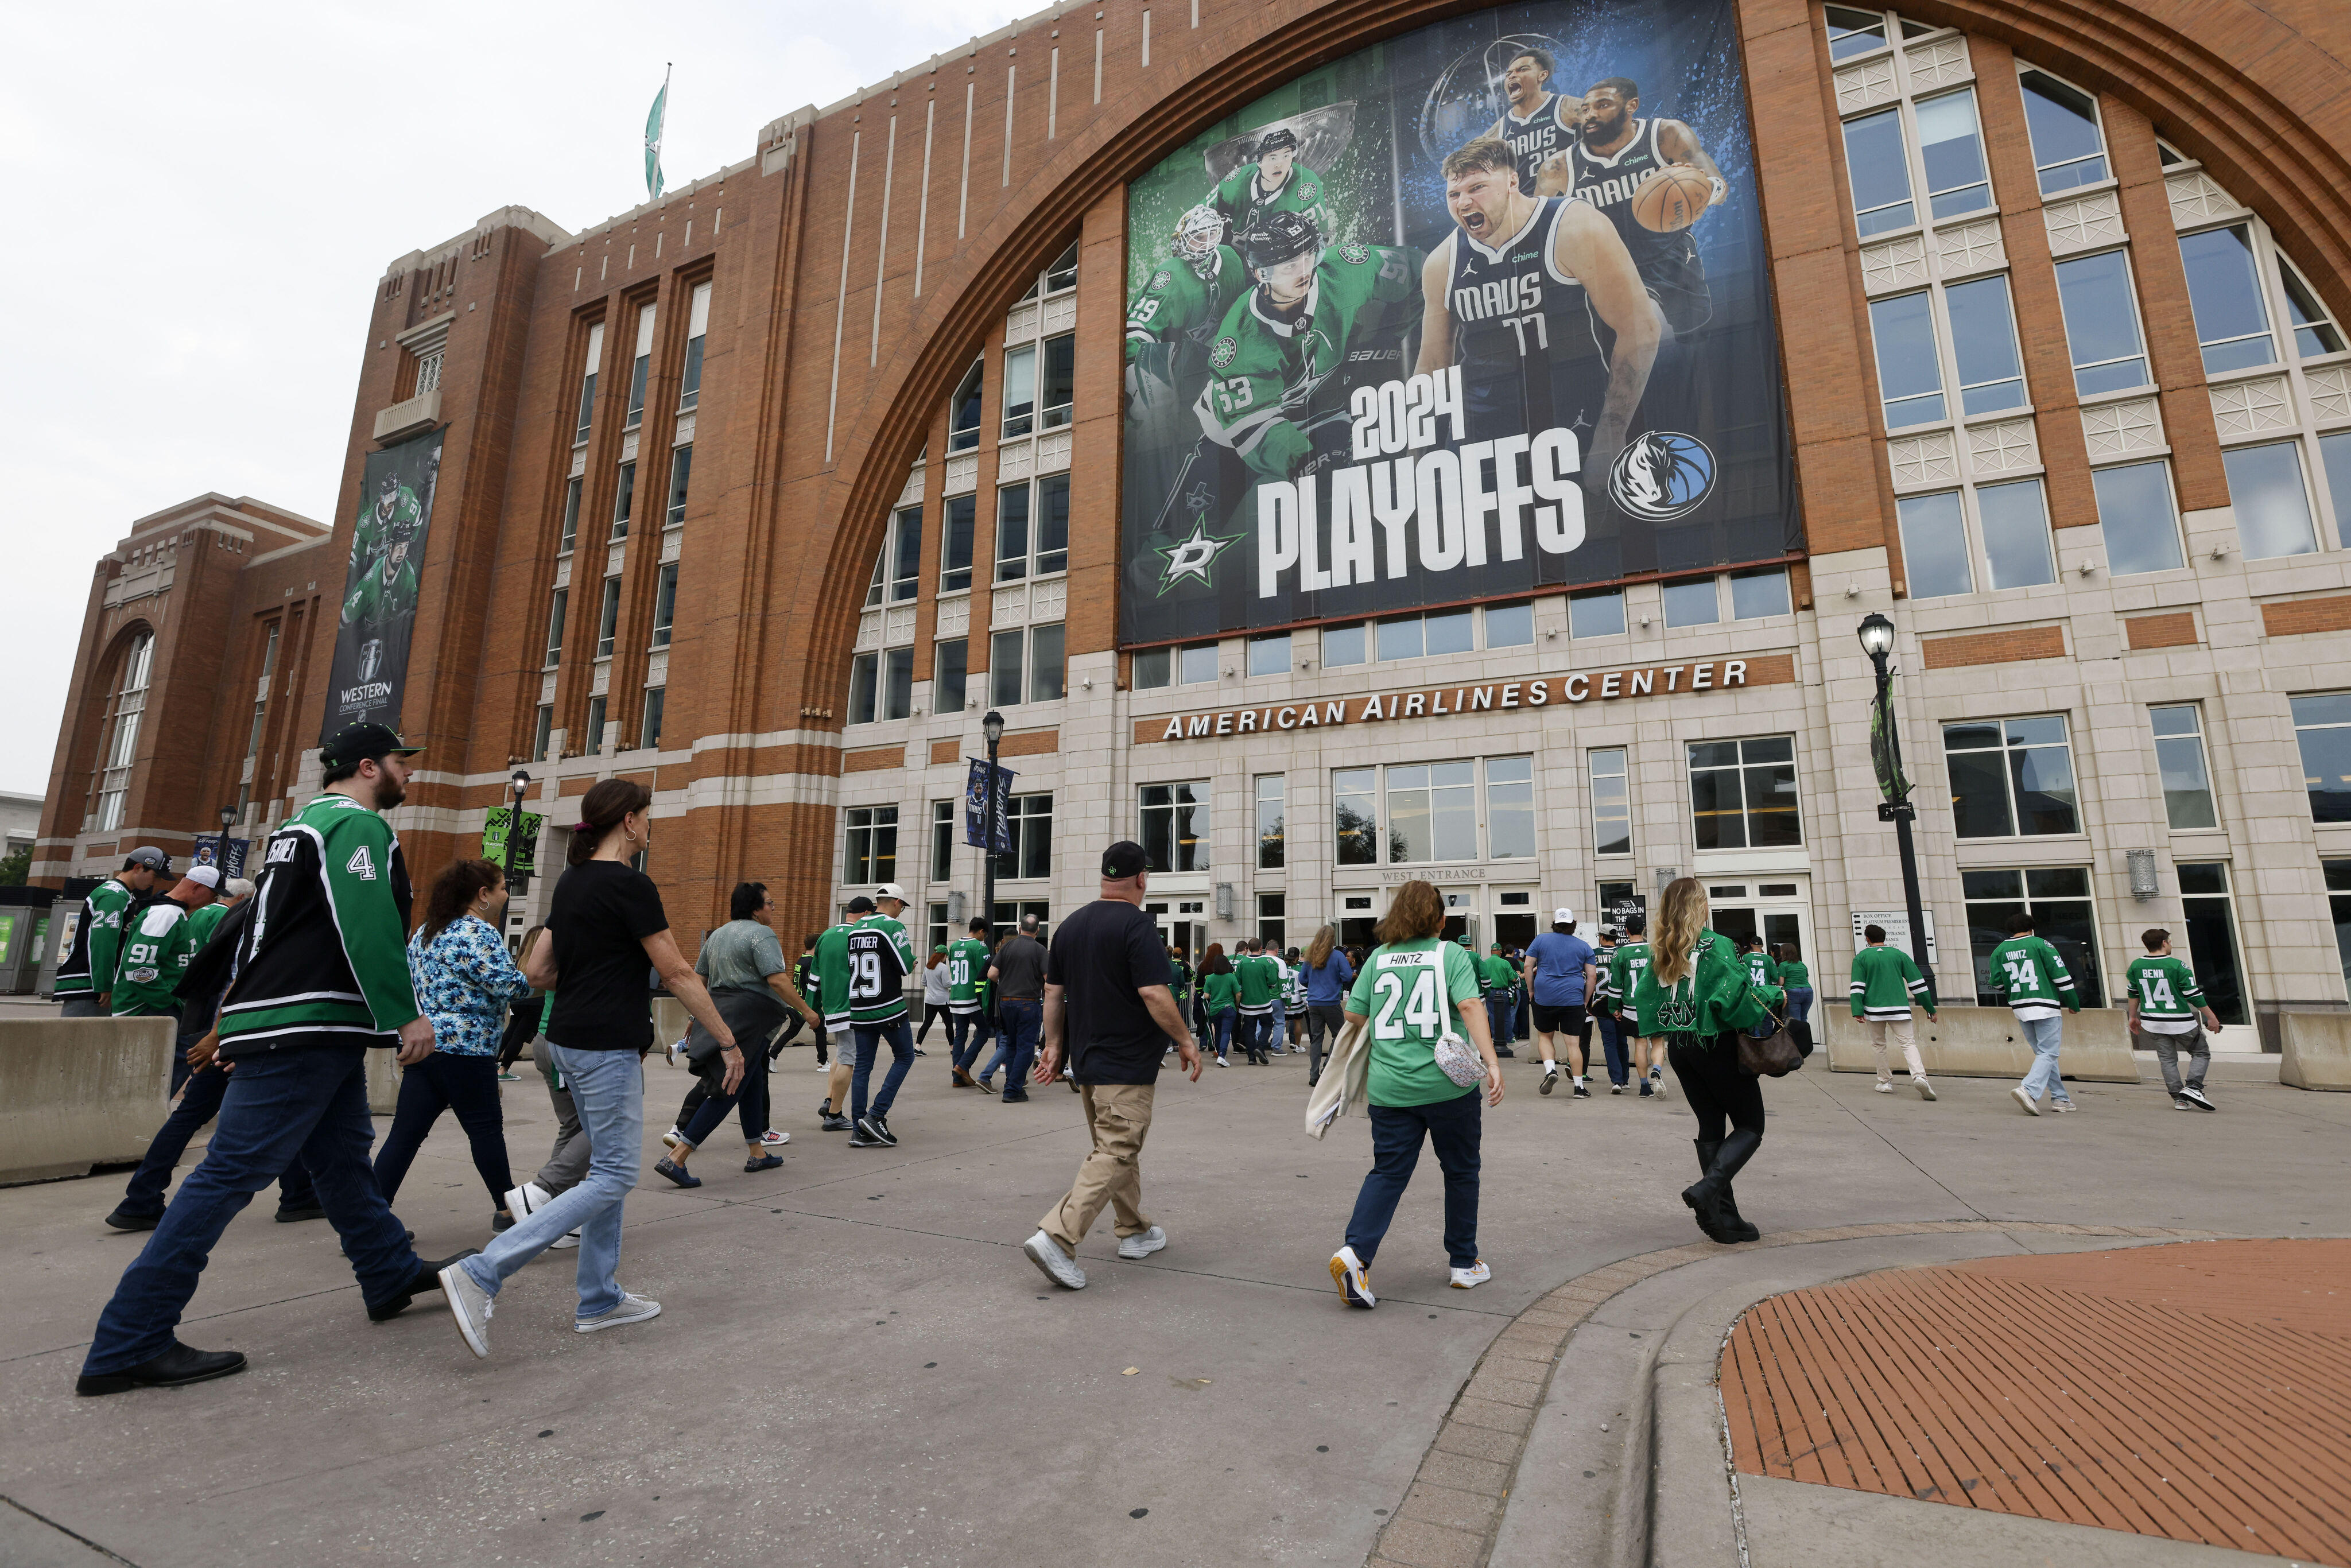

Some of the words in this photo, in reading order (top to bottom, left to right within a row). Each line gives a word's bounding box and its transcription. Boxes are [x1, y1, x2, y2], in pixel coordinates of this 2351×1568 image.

[1534, 115, 1551, 123] chime
[1624, 153, 1648, 166] chime
[1512, 251, 1539, 263] chime
[1454, 271, 1542, 322] MAVS
[1502, 312, 1549, 356] 77
[1351, 365, 1465, 461] 2024
[1258, 427, 1586, 599] PLAYOFFS
[341, 681, 392, 704] WESTERN
[1162, 700, 1346, 740] AMERICAN
[1360, 681, 1549, 720] AIRLINES
[1564, 660, 1747, 703] CENTER
[339, 699, 372, 713] CONFERENCE
[373, 697, 387, 706] FINAL
[996, 775, 1006, 838] PLAYOFFS
[976, 814, 981, 825] 11
[346, 845, 377, 881] 4
[1382, 871, 1414, 882] WEST
[1420, 868, 1485, 880] ENTRANCE
[92, 910, 120, 929] 24
[129, 944, 158, 964] 91
[849, 936, 878, 950] ETTINGER
[1390, 953, 1423, 965] HINTZ
[2005, 949, 2027, 961] HINTZ
[848, 951, 882, 999] 29
[951, 959, 969, 985] 30
[2002, 959, 2039, 993] 24
[2142, 969, 2164, 978] BENN
[1374, 969, 1440, 1041] 24
[2139, 979, 2177, 1009] 14
